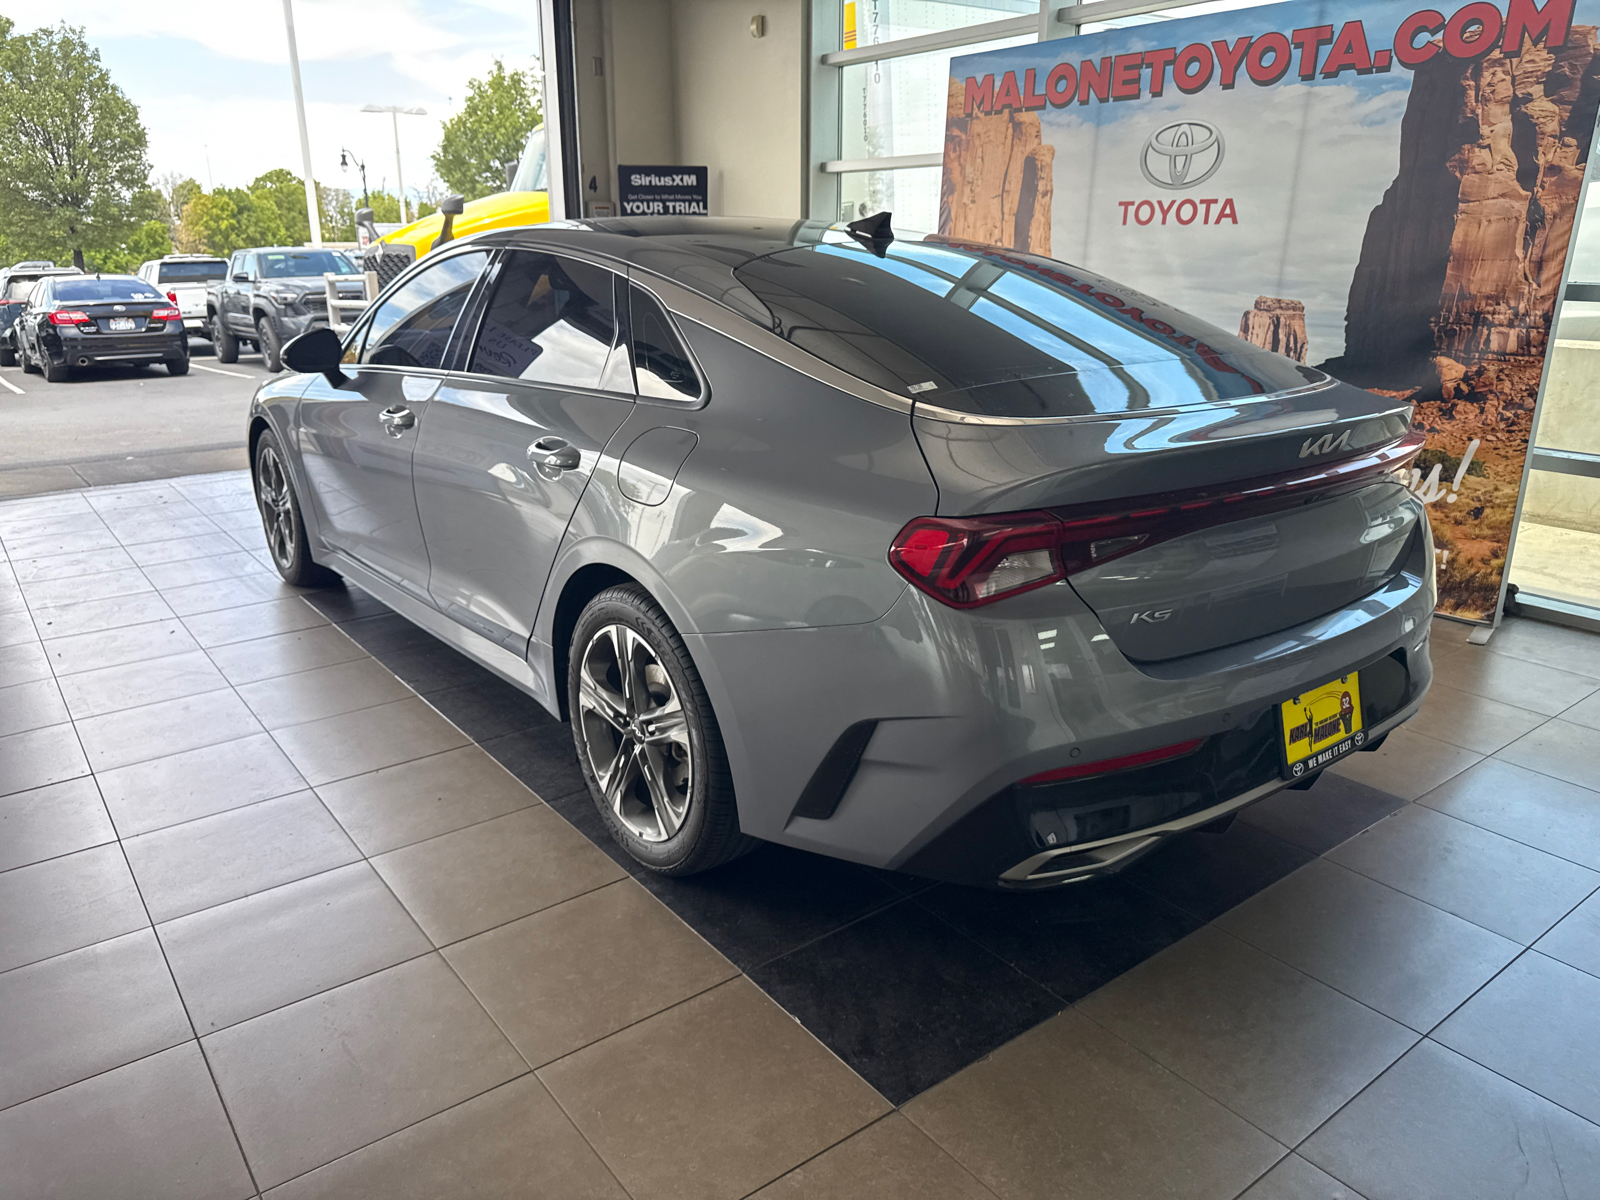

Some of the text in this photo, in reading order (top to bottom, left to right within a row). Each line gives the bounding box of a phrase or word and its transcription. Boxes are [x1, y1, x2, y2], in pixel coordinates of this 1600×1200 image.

[965, 0, 1573, 117] MALONETOYOTA.COM
[588, 175, 598, 193] 4
[630, 175, 697, 186] SiriusXM
[623, 202, 664, 214] YOUR
[665, 202, 708, 214] TRIAL
[1118, 198, 1239, 226] TOYOTA
[1298, 429, 1351, 458] KIA
[1130, 608, 1174, 625] K5
[1342, 697, 1350, 709] 32
[1289, 721, 1310, 746] KARL
[1313, 717, 1342, 745] MALONE
[1308, 740, 1351, 768] WE MAKE IT EASY
